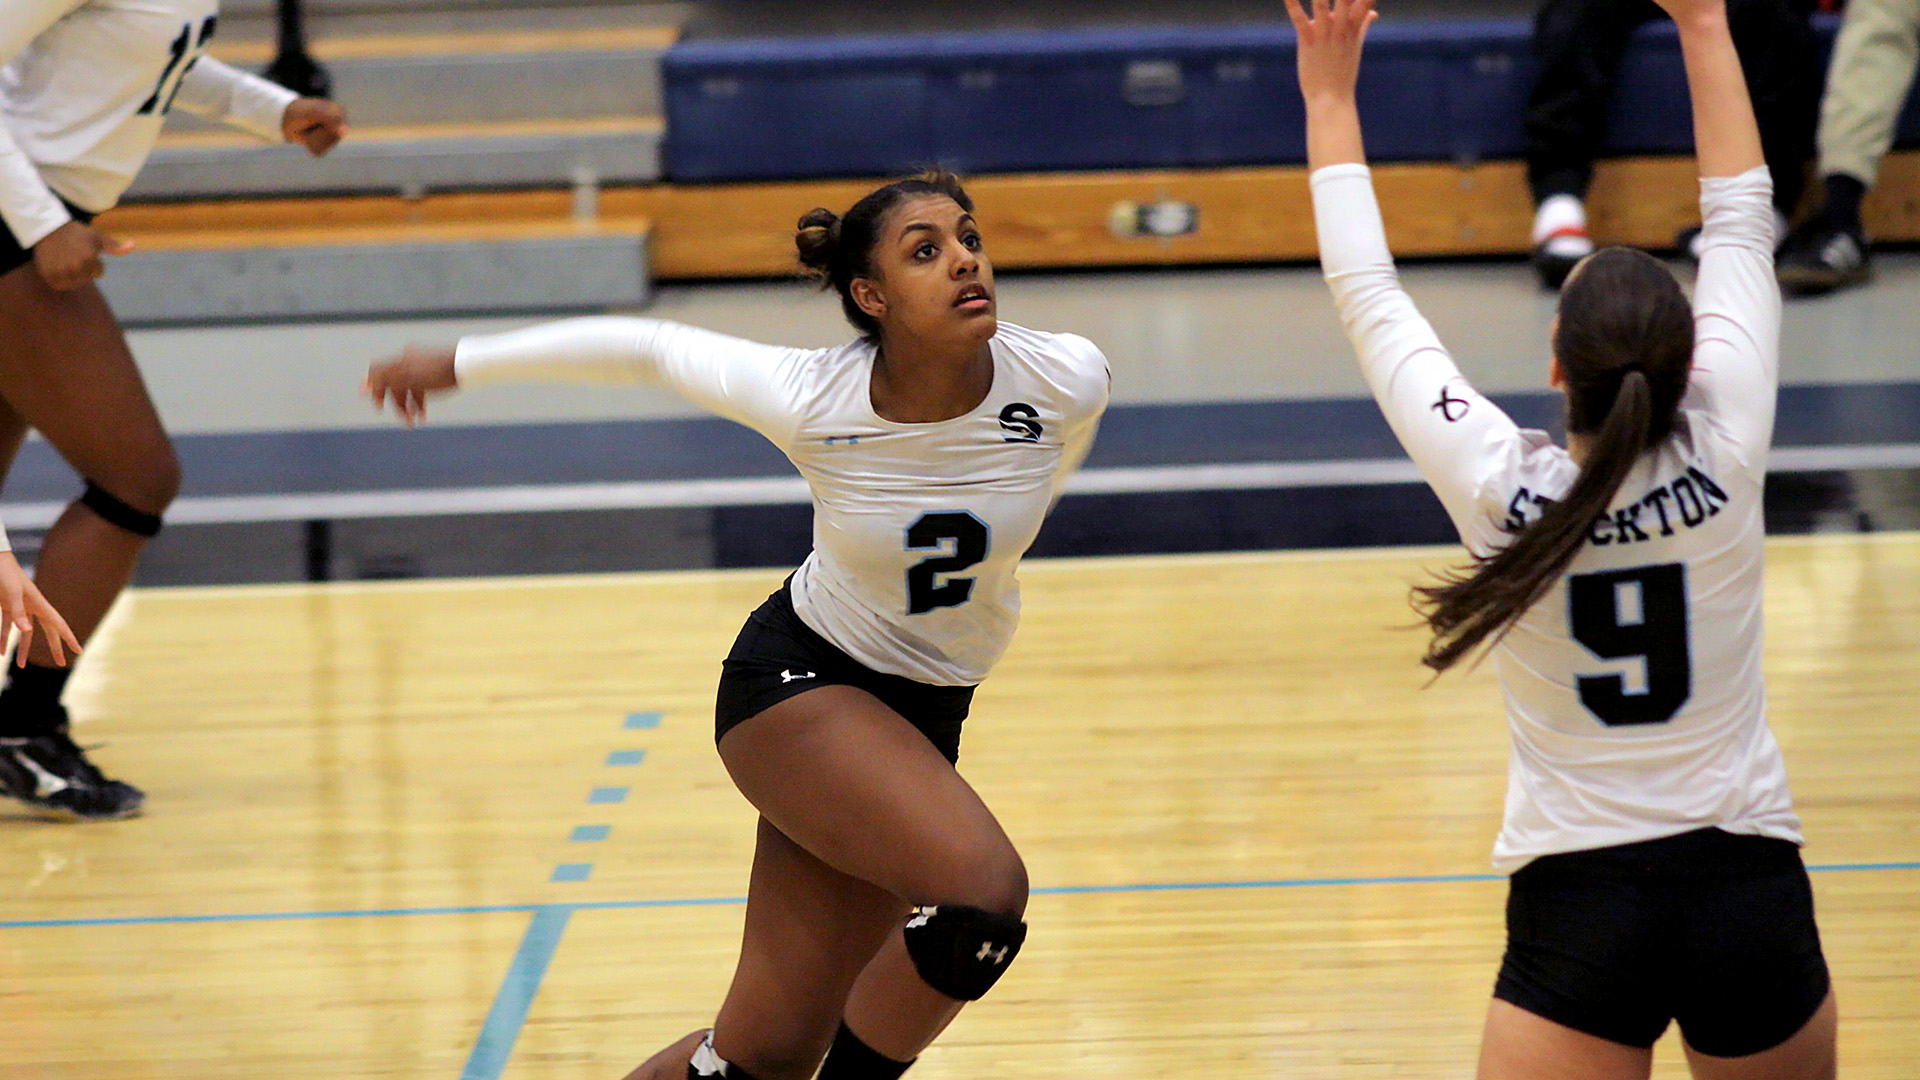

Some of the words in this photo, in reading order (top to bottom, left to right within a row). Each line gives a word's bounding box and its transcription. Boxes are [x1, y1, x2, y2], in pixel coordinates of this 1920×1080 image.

[1504, 464, 1729, 545] SCKTON
[903, 508, 992, 616] 2
[1566, 561, 1692, 728] 9
